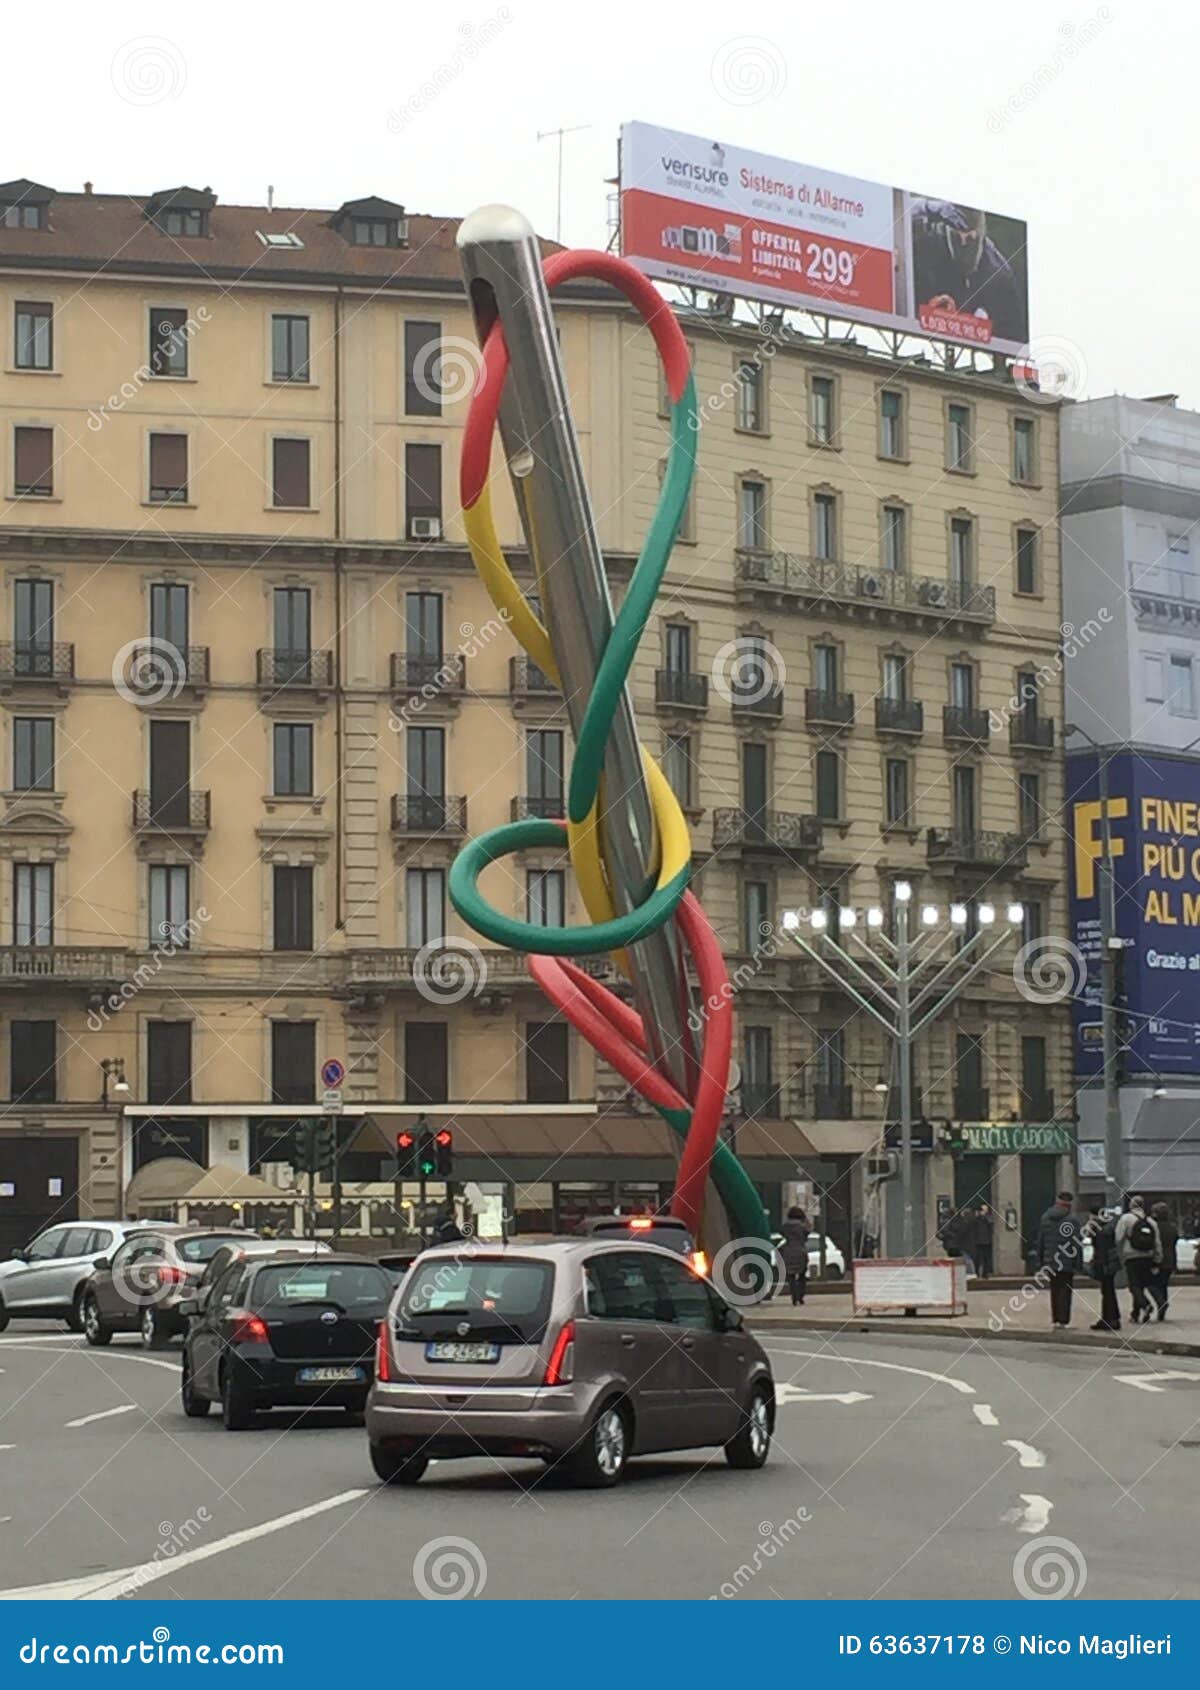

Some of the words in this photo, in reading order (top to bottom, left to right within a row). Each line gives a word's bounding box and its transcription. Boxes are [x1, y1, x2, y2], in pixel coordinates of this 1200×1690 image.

[661, 156, 729, 187] verisure
[740, 168, 795, 200] Sistema
[798, 184, 811, 205] di
[814, 188, 864, 218] Allarme
[751, 228, 801, 254] OFFERTA
[751, 248, 802, 273] LIMITATA
[1141, 797, 1200, 837] FINE
[1074, 798, 1128, 899] F
[1143, 837, 1186, 881] PIÙ
[1144, 890, 1178, 925] AL
[1146, 949, 1187, 970] Grazie
[962, 1128, 1011, 1150] MACIA
[1012, 1128, 1072, 1151] CADORNA
